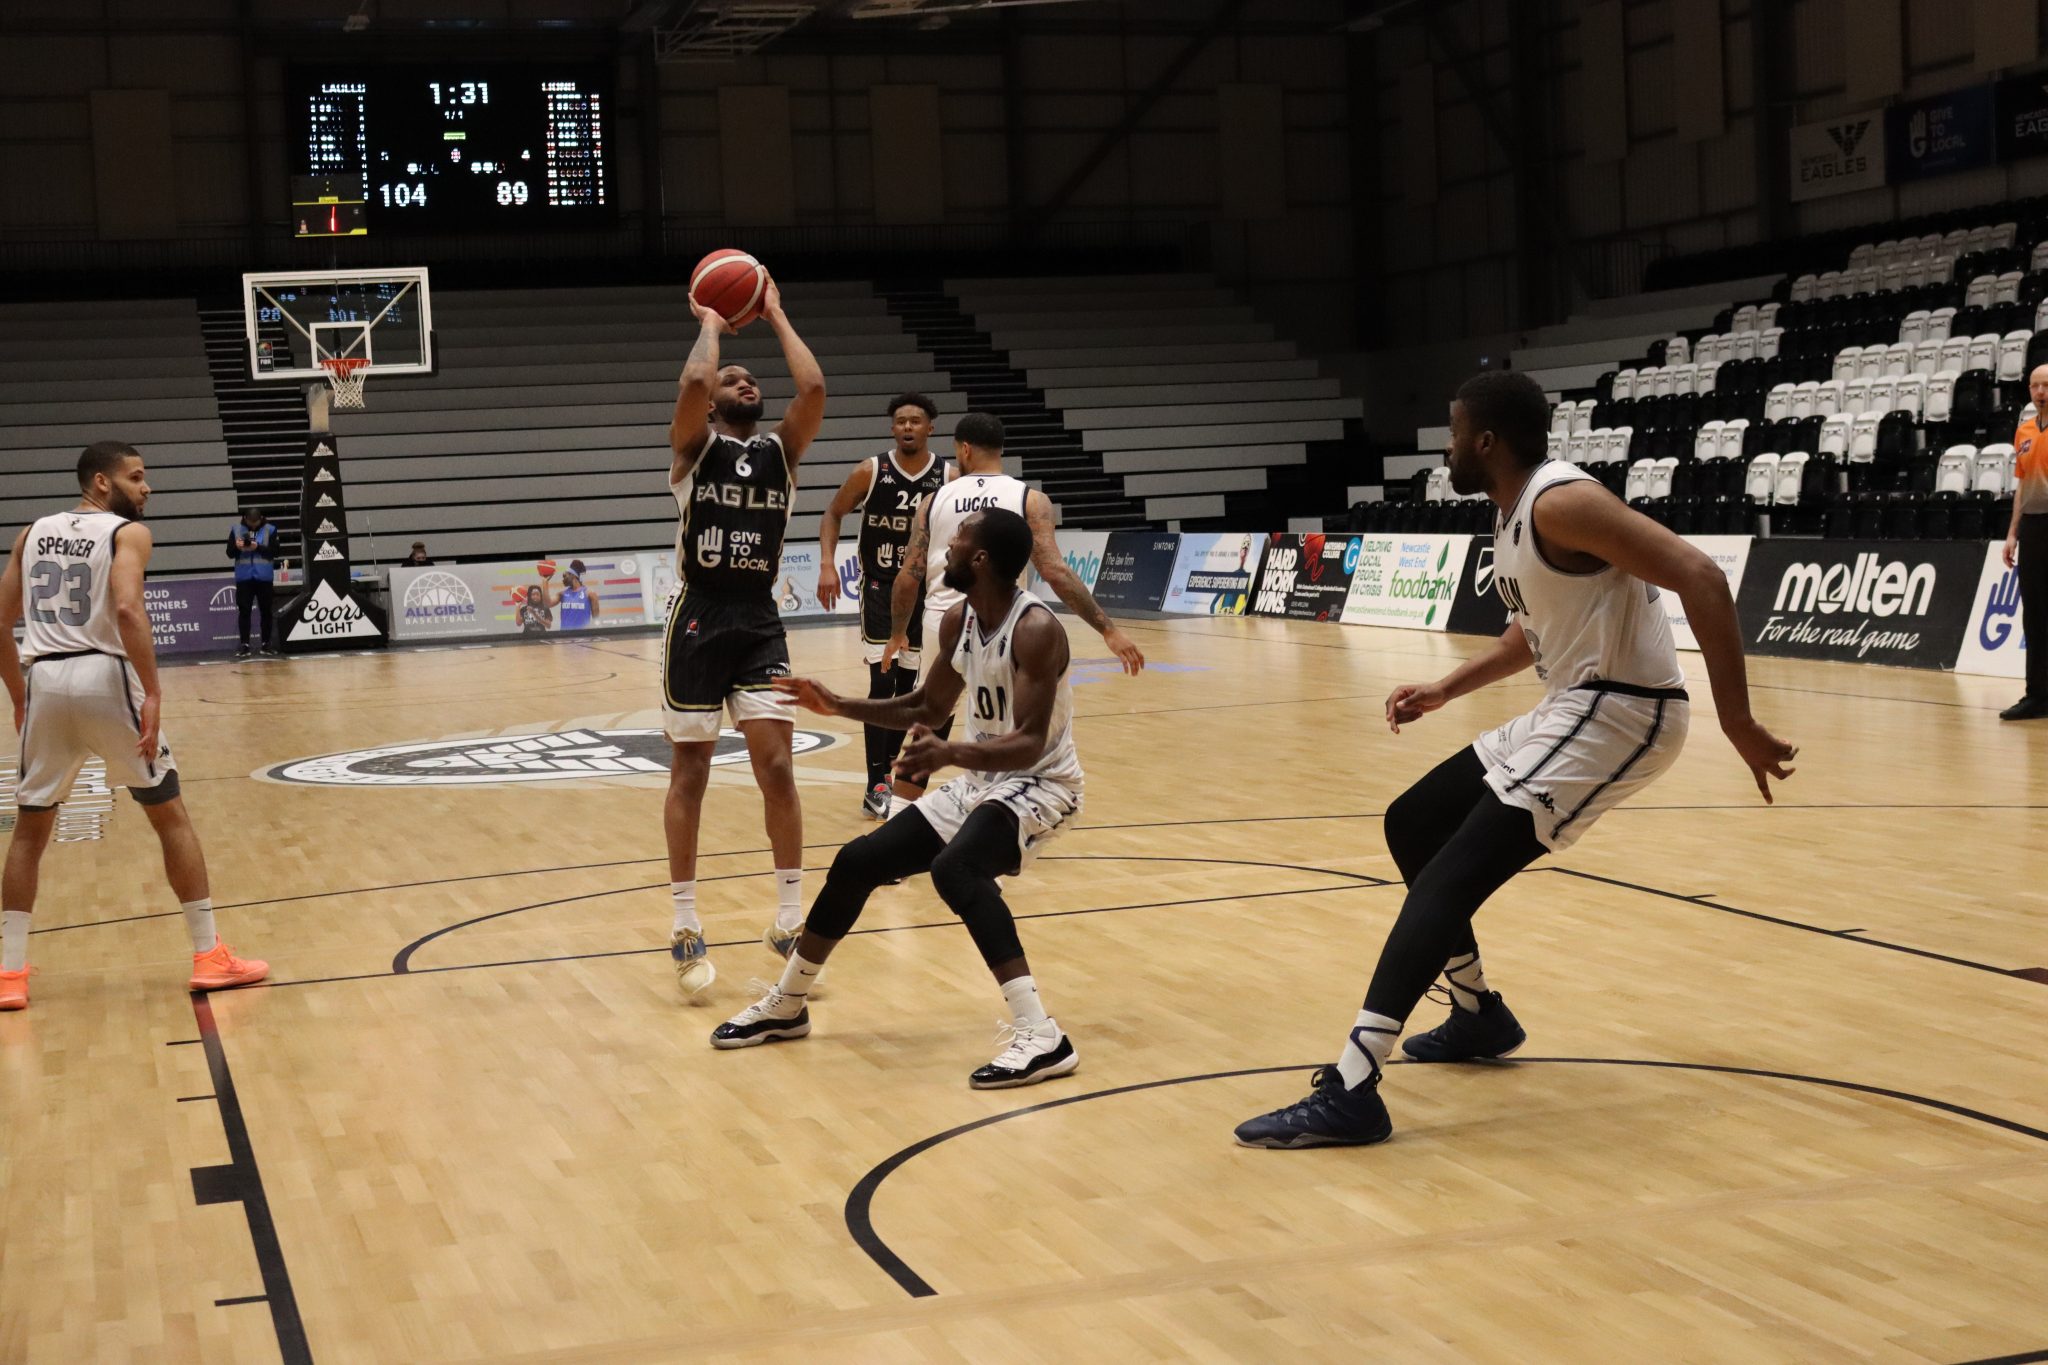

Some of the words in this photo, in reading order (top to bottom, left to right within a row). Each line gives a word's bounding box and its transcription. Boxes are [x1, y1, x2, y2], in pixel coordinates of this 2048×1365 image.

[429, 82, 489, 104] 1:31
[1930, 106, 1954, 122] GIVE
[2015, 109, 2048, 121] NEWCAST
[1930, 123, 1945, 137] TO
[2015, 117, 2048, 139] EAG
[1932, 136, 1967, 153] LOCAL
[1801, 156, 1867, 183] EAGLES
[379, 182, 427, 207] 104
[497, 181, 529, 205] 89
[735, 452, 752, 477] 6
[696, 482, 786, 510] EAGLES
[896, 490, 922, 510] 24
[955, 496, 998, 513] LUCAS
[868, 514, 907, 531] EAG
[730, 530, 762, 545] GIVE
[38, 536, 96, 558] SPENCER
[730, 544, 751, 556] TO
[1362, 540, 1393, 553] HELPING
[1401, 542, 1431, 554] Newcastle
[730, 556, 769, 572] LOCAL
[782, 554, 811, 564] erent
[1105, 552, 1115, 565] The
[1115, 552, 1124, 565] law
[1124, 553, 1134, 566] firm
[1266, 548, 1298, 570] HARD
[1359, 554, 1382, 567] LOCAL
[1399, 556, 1413, 568] West
[1414, 556, 1426, 568] End
[1100, 568, 1107, 581] of
[1107, 569, 1134, 584] champions
[1262, 570, 1298, 592] WORK
[1355, 569, 1382, 582] PEOPLE
[1350, 583, 1359, 596] IN
[1359, 584, 1382, 597] CRISIS
[1388, 570, 1457, 601] foodbank
[1773, 552, 1936, 617] molten
[30, 560, 92, 626] 23
[144, 590, 170, 599] OUD
[145, 600, 188, 610] RTNERS
[300, 600, 365, 624] Coors
[405, 607, 432, 618] ALL
[434, 604, 475, 616] GIRLS
[150, 612, 171, 622] THE
[405, 615, 476, 625] BASKETBALL
[152, 622, 200, 634] WCASTLE
[312, 622, 352, 635] LIGHT
[152, 636, 176, 646] LES
[1756, 616, 1790, 643] For
[1790, 616, 1818, 644] the
[1819, 619, 1869, 647] real
[1858, 630, 1920, 658] game
